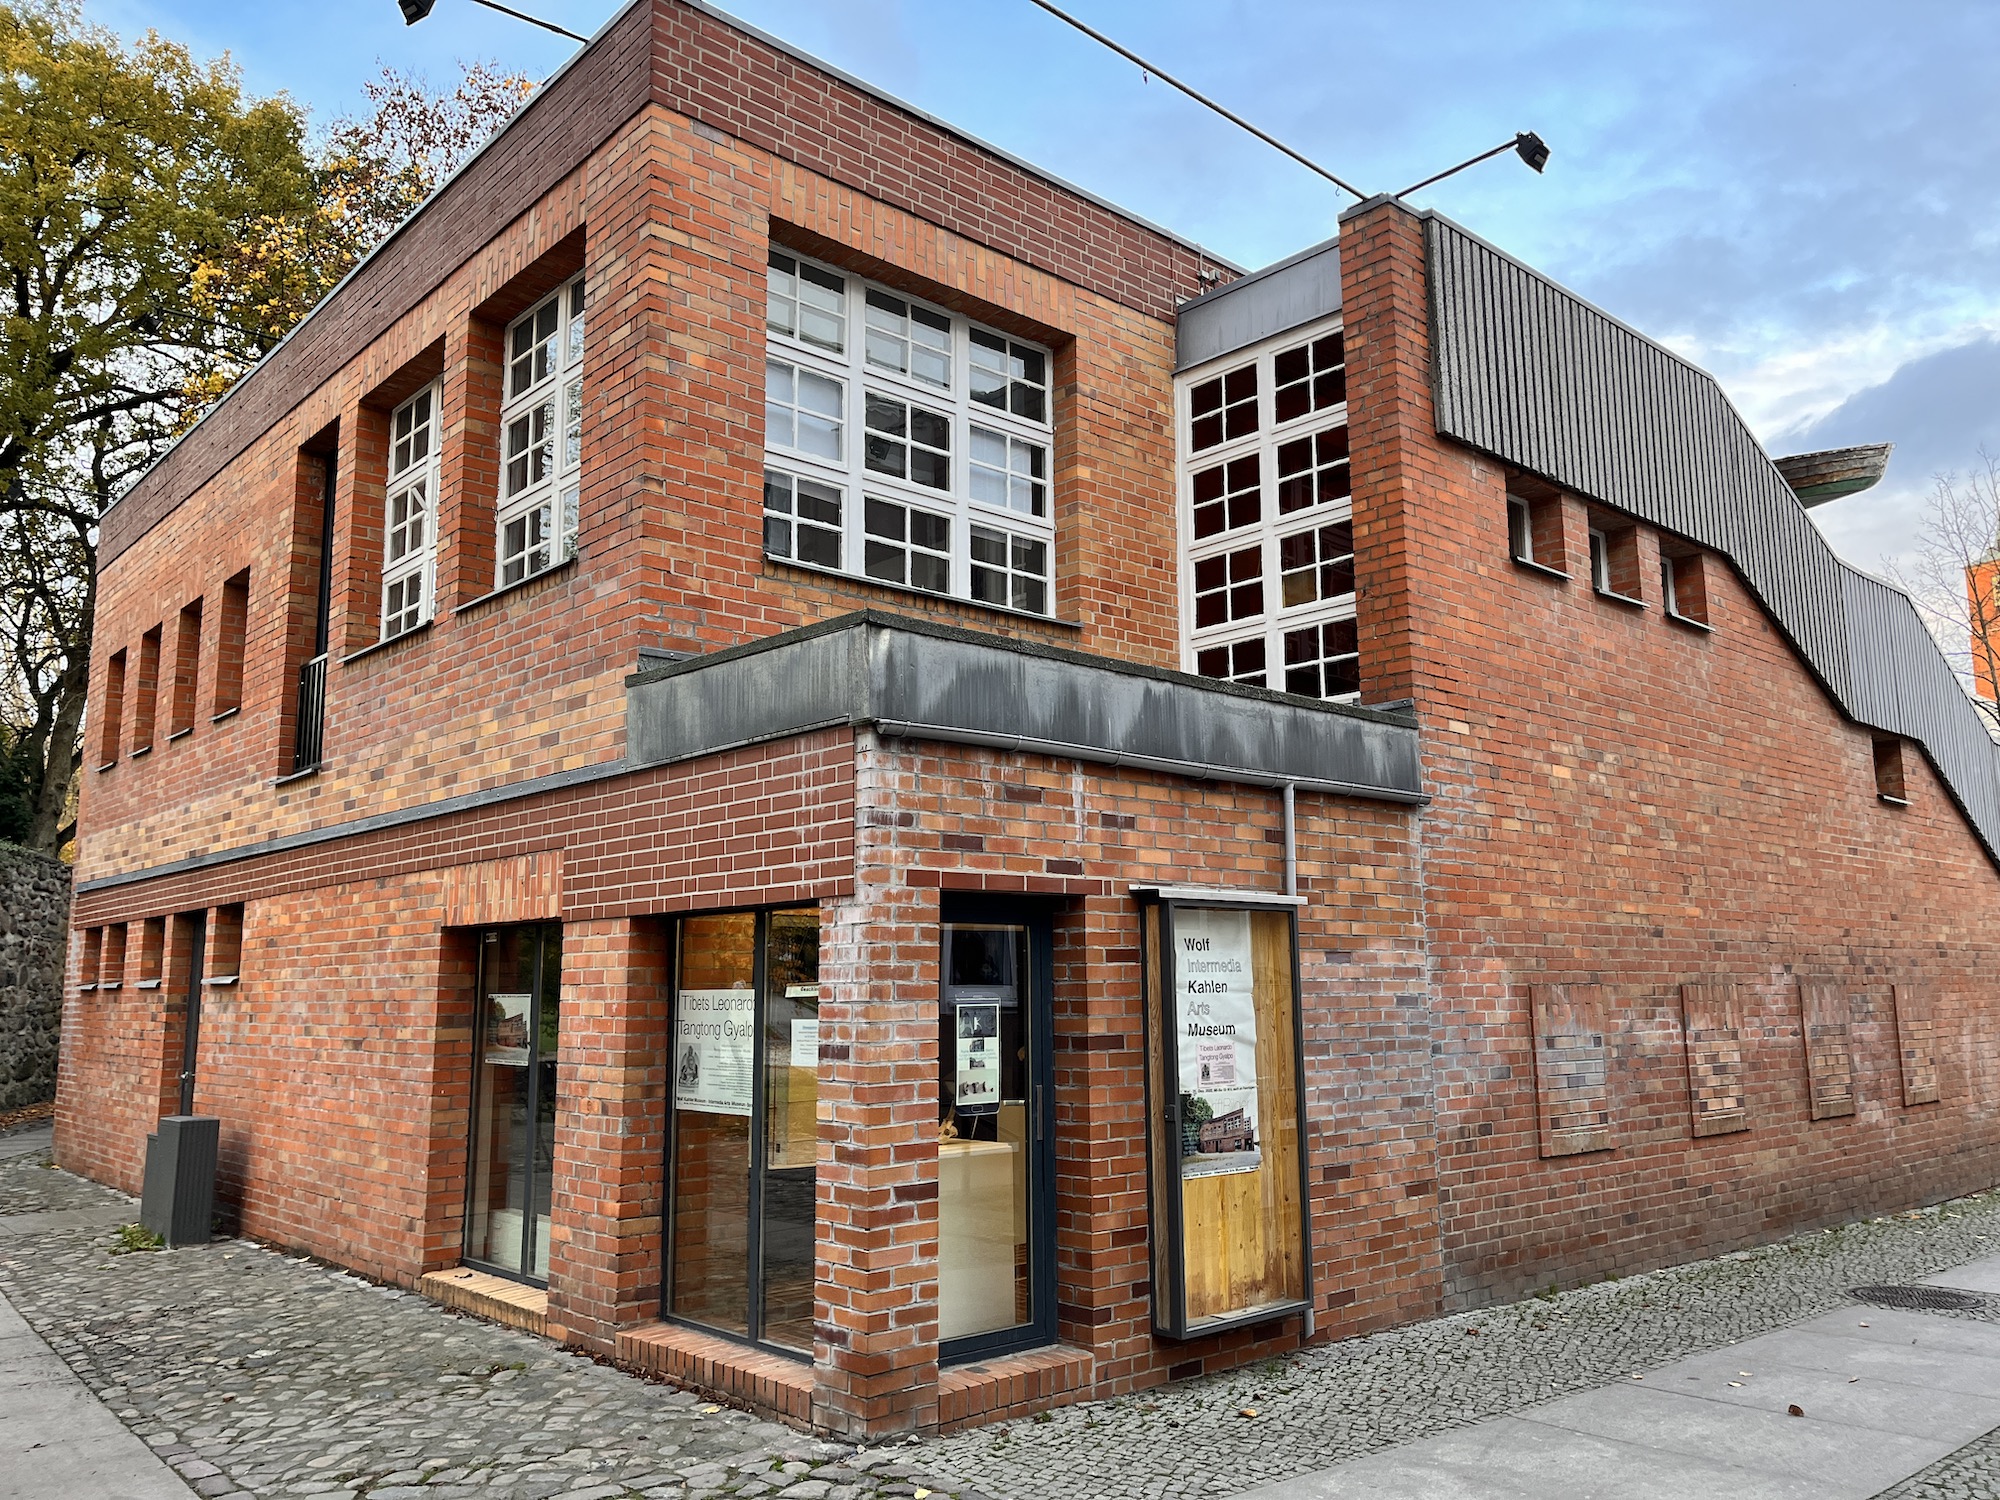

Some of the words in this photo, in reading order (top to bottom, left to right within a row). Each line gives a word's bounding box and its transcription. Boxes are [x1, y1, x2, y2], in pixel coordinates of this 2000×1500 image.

[1184, 937, 1210, 951] Wolf
[1187, 958, 1242, 973] Intermedia
[1188, 980, 1228, 994] Kahlen
[681, 995, 710, 1011] Tibets
[712, 995, 755, 1011] Leonard
[1187, 1001, 1210, 1016] Arts
[677, 1019, 721, 1041] Tangtong
[1188, 1023, 1236, 1037] Museum
